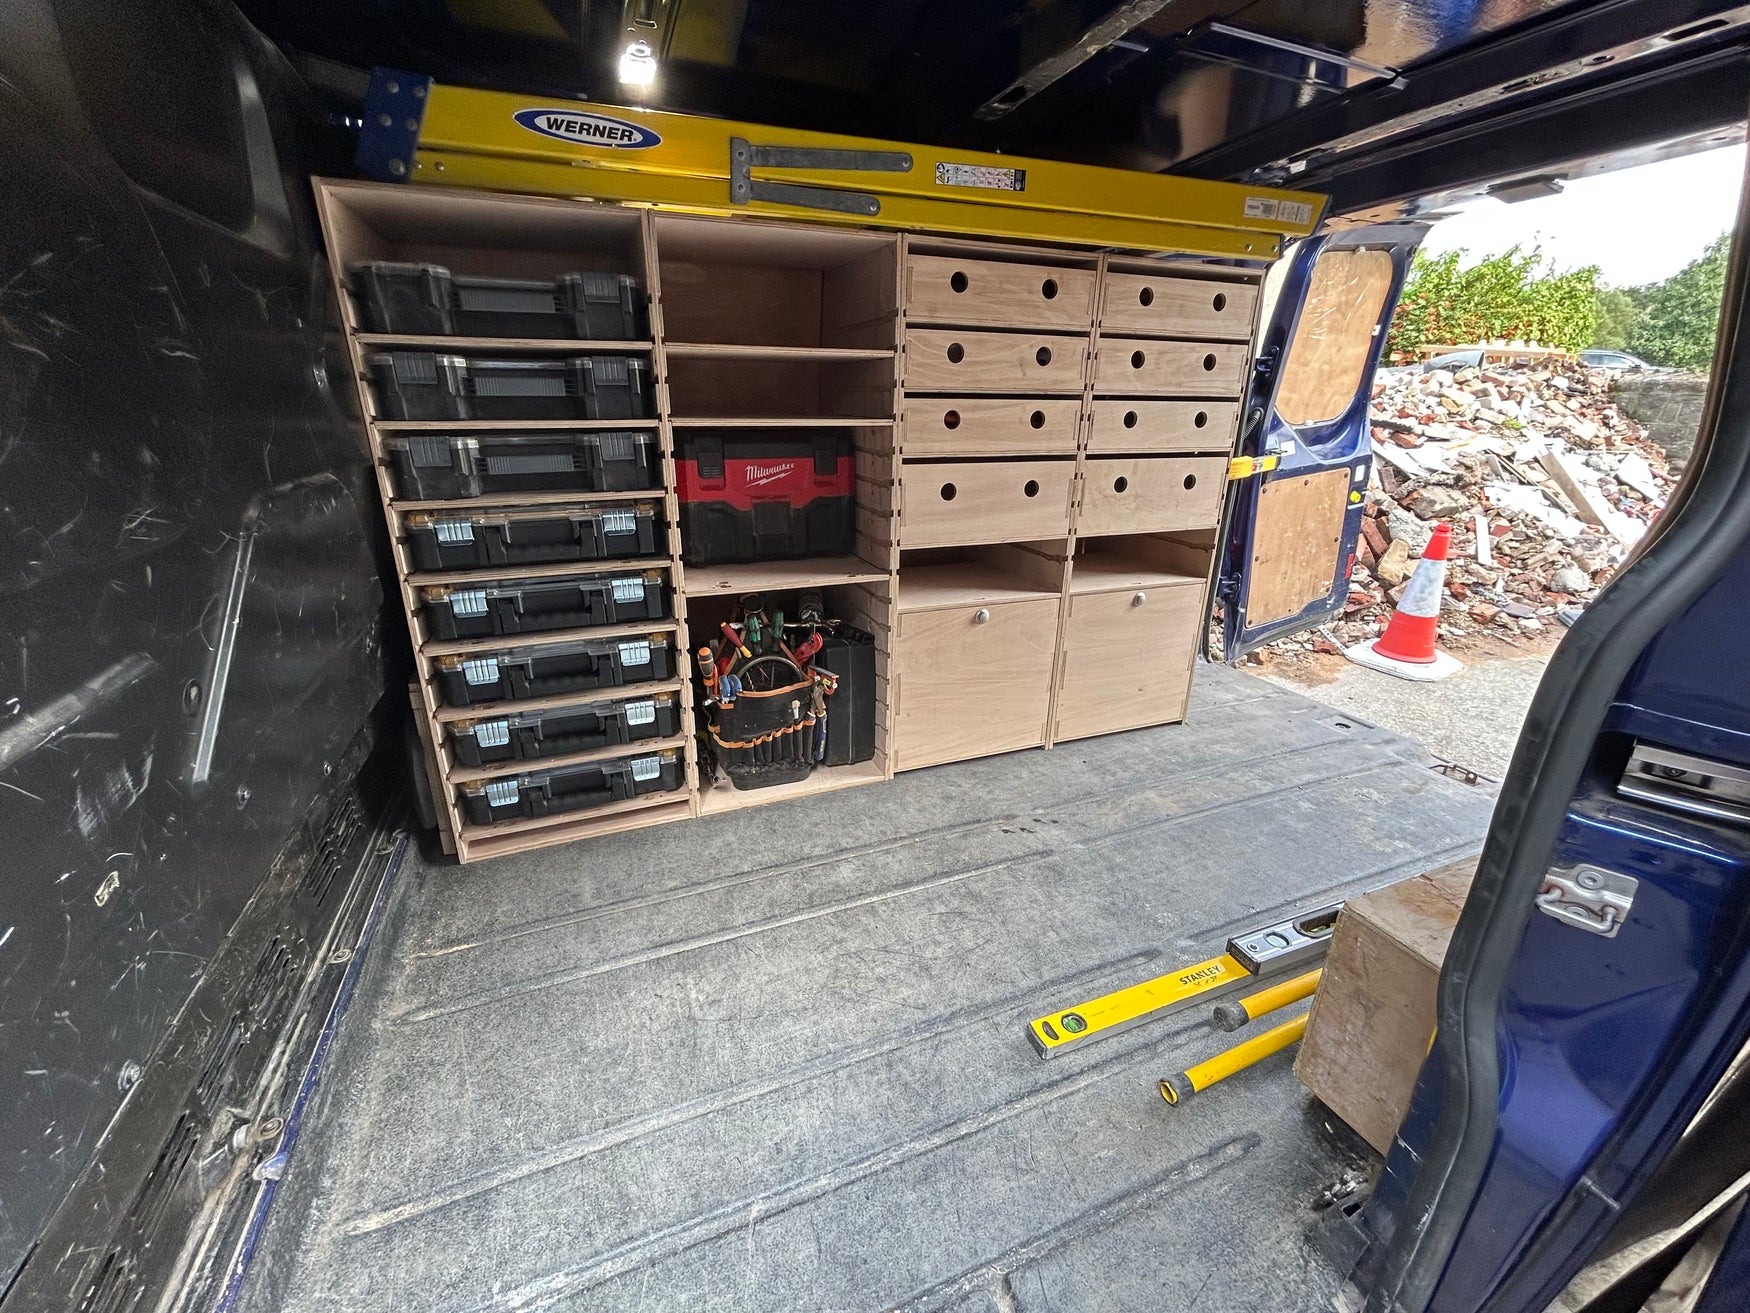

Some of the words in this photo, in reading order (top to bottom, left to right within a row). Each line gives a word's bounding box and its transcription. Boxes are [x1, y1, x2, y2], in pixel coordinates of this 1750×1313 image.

[546, 116, 634, 142] WERNER
[745, 463, 794, 481] Milwaukee
[1179, 965, 1221, 985] STANLEY
